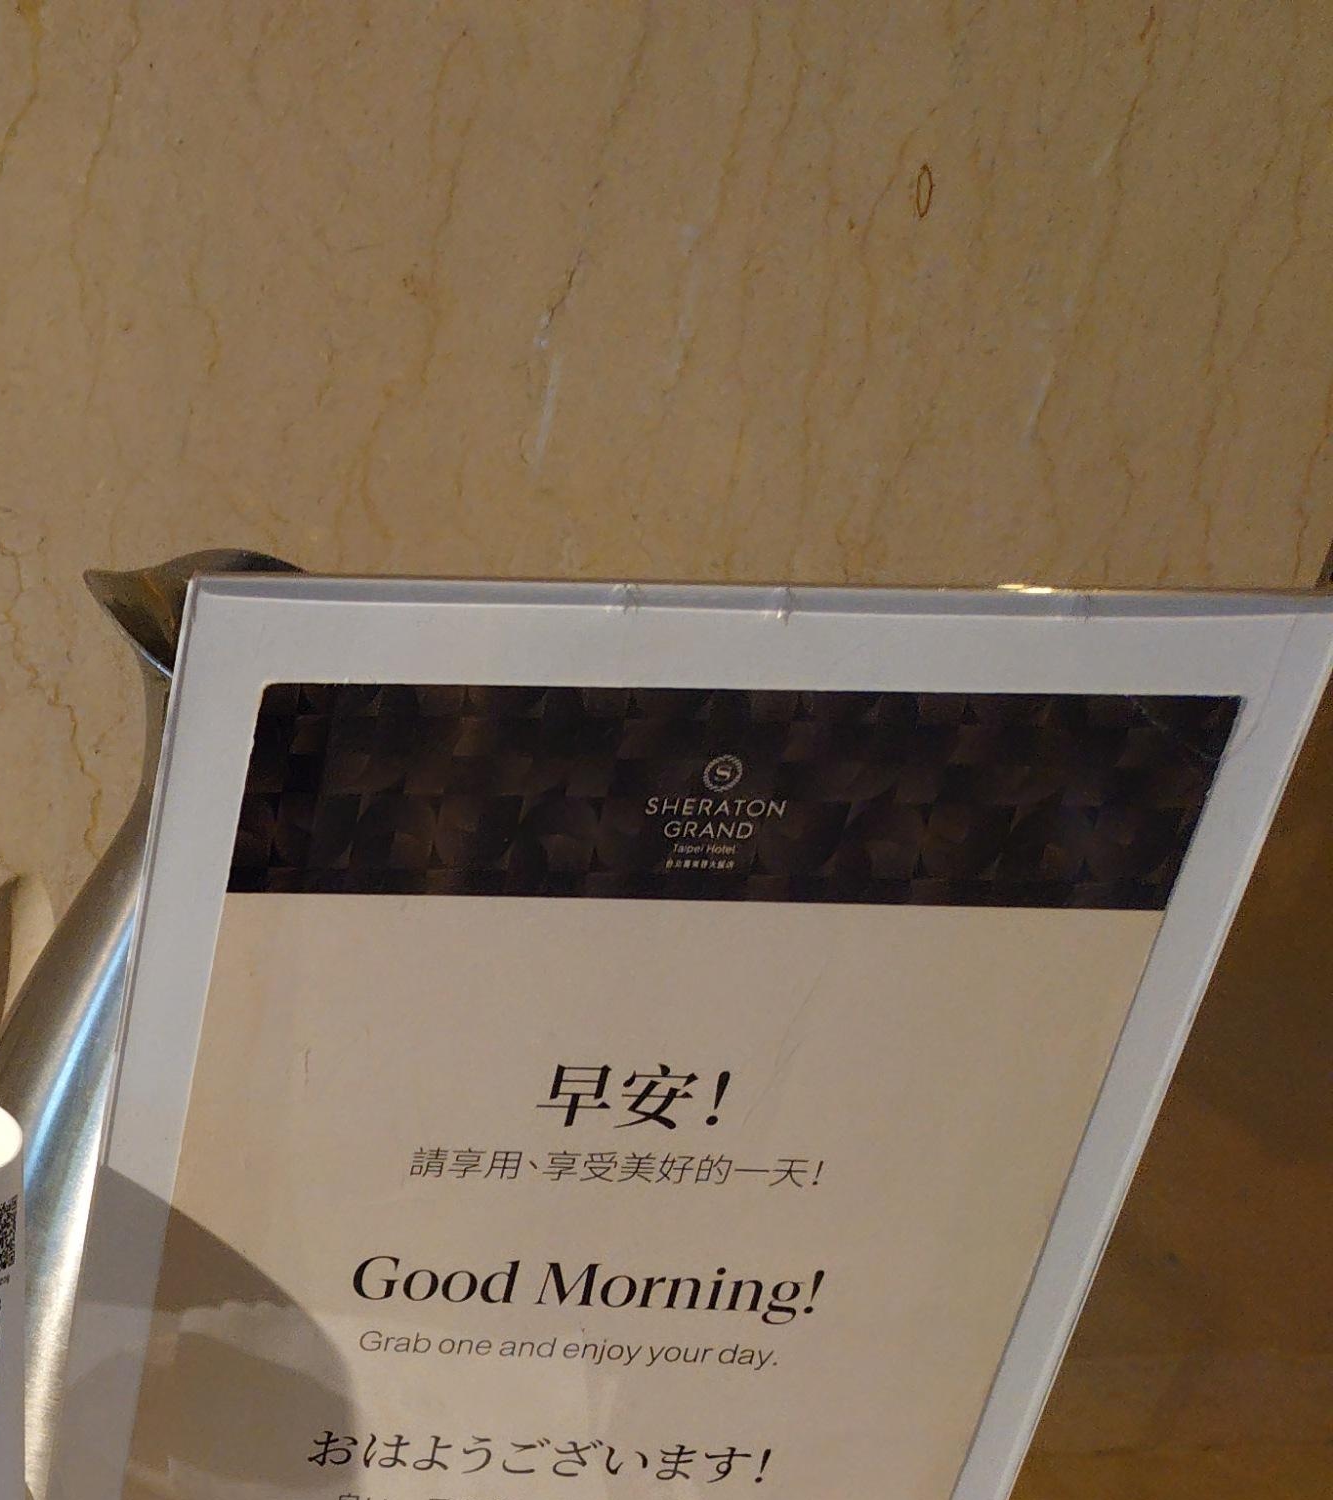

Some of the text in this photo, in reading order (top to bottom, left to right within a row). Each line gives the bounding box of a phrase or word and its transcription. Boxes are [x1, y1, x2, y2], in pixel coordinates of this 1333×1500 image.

[644, 797, 787, 818] SHERATON
[664, 820, 755, 840] GRAND
[672, 843, 737, 855] Taipei Hotel
[536, 1063, 731, 1131] 早安!
[352, 1255, 825, 1325] Good Morning!
[358, 1330, 779, 1370] Grab one and enjoy your day.
[308, 1430, 772, 1484] おはようございます!
